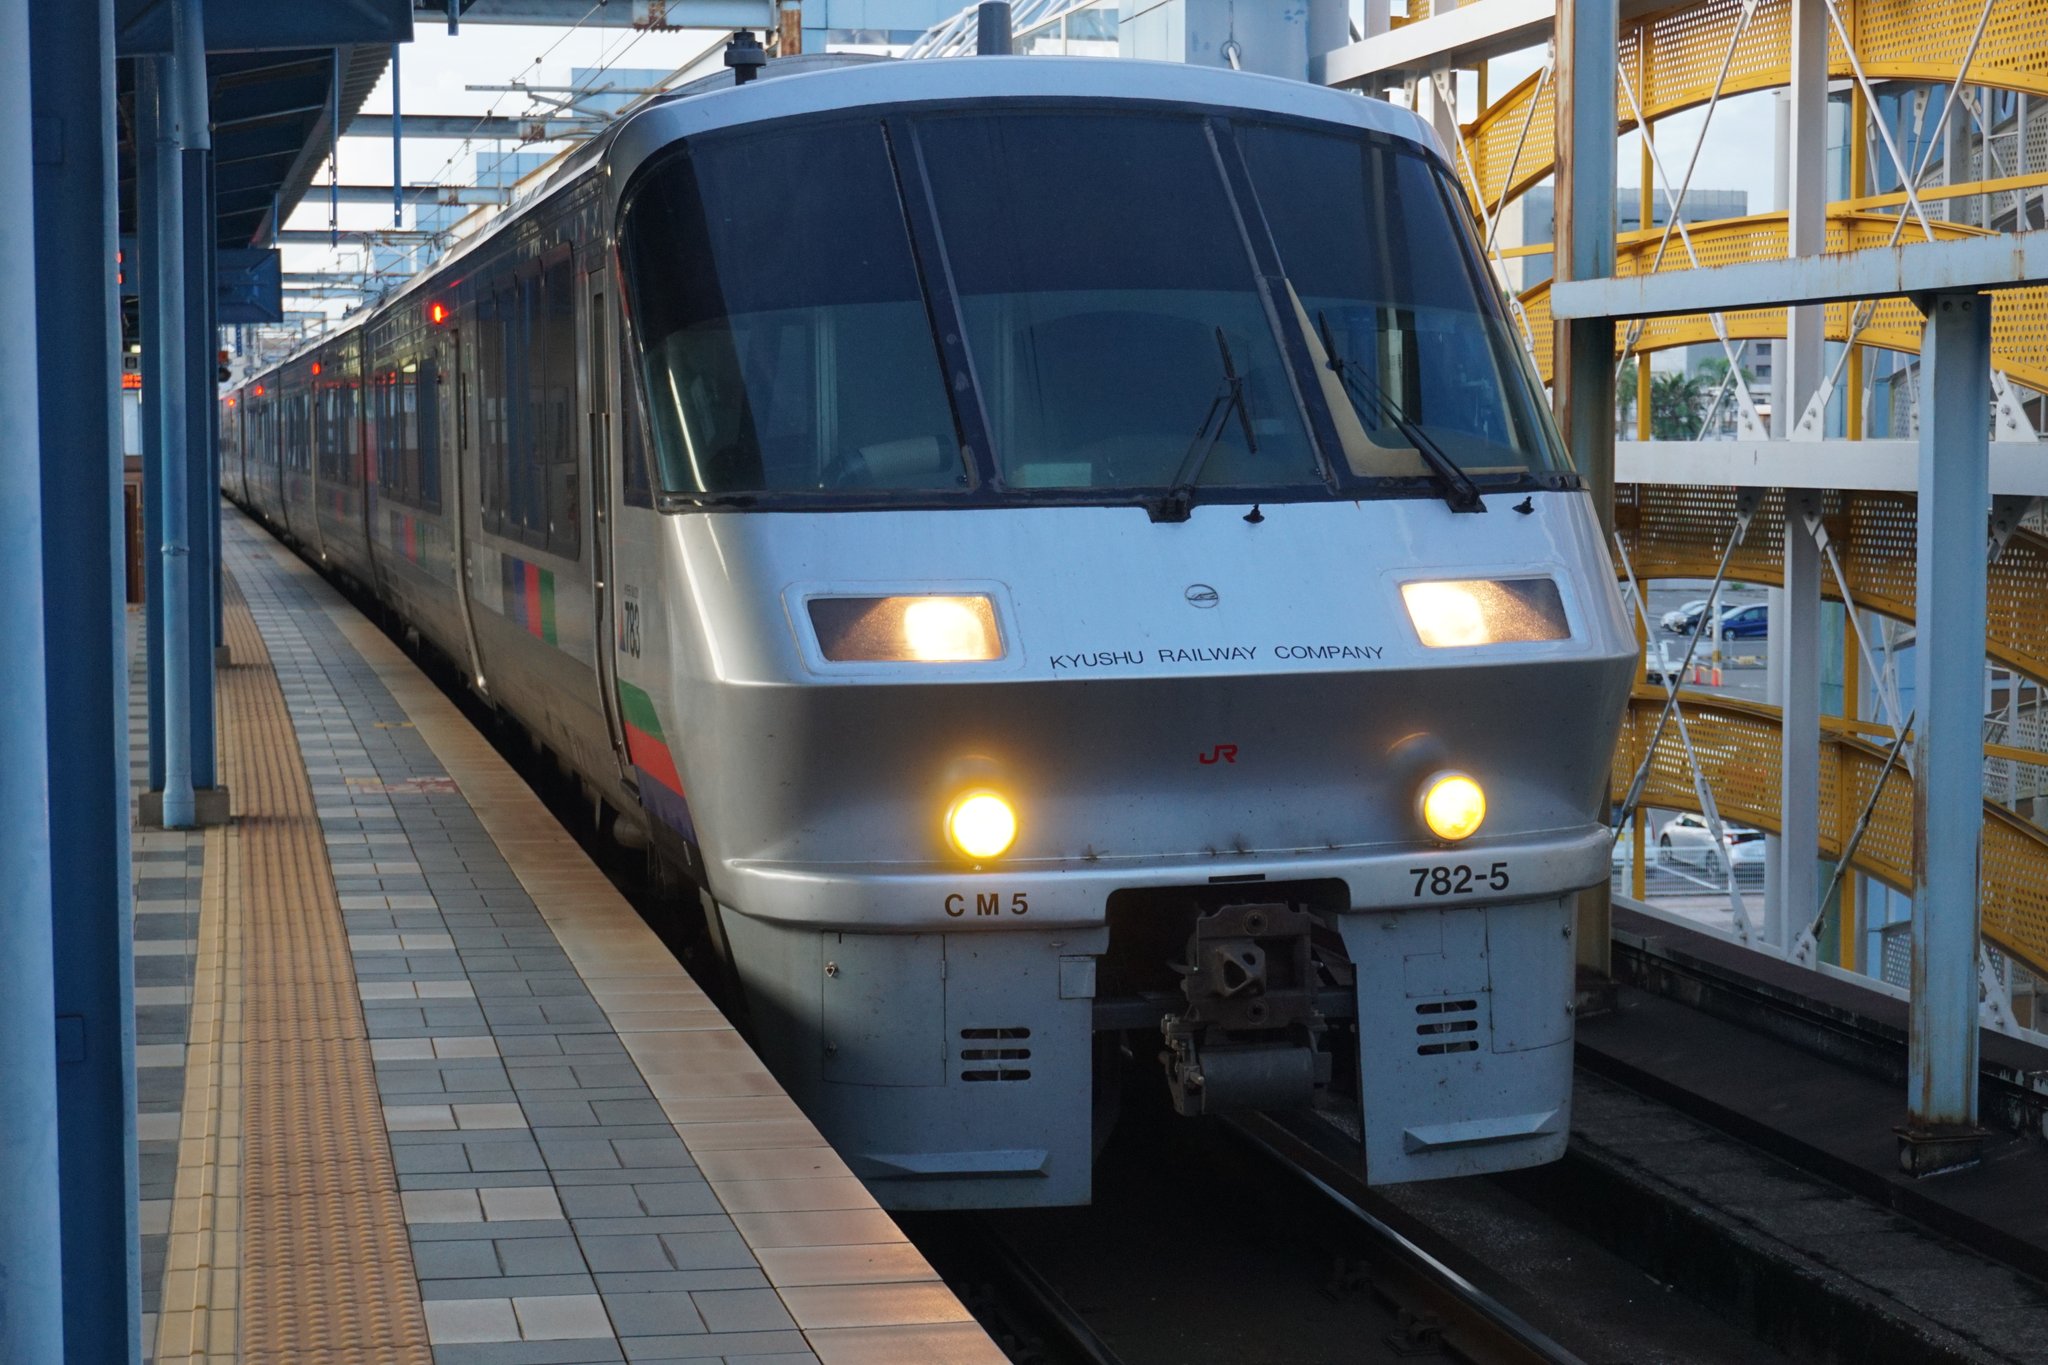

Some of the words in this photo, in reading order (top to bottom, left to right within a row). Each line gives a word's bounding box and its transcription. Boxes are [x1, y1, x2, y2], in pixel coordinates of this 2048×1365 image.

[625, 601, 640, 659] 783
[1050, 650, 1144, 669] KYUSHU
[1158, 646, 1257, 662] RAILWAY
[1274, 645, 1383, 660] COMPANY
[1199, 744, 1238, 765] JR
[1409, 862, 1510, 897] 782-5
